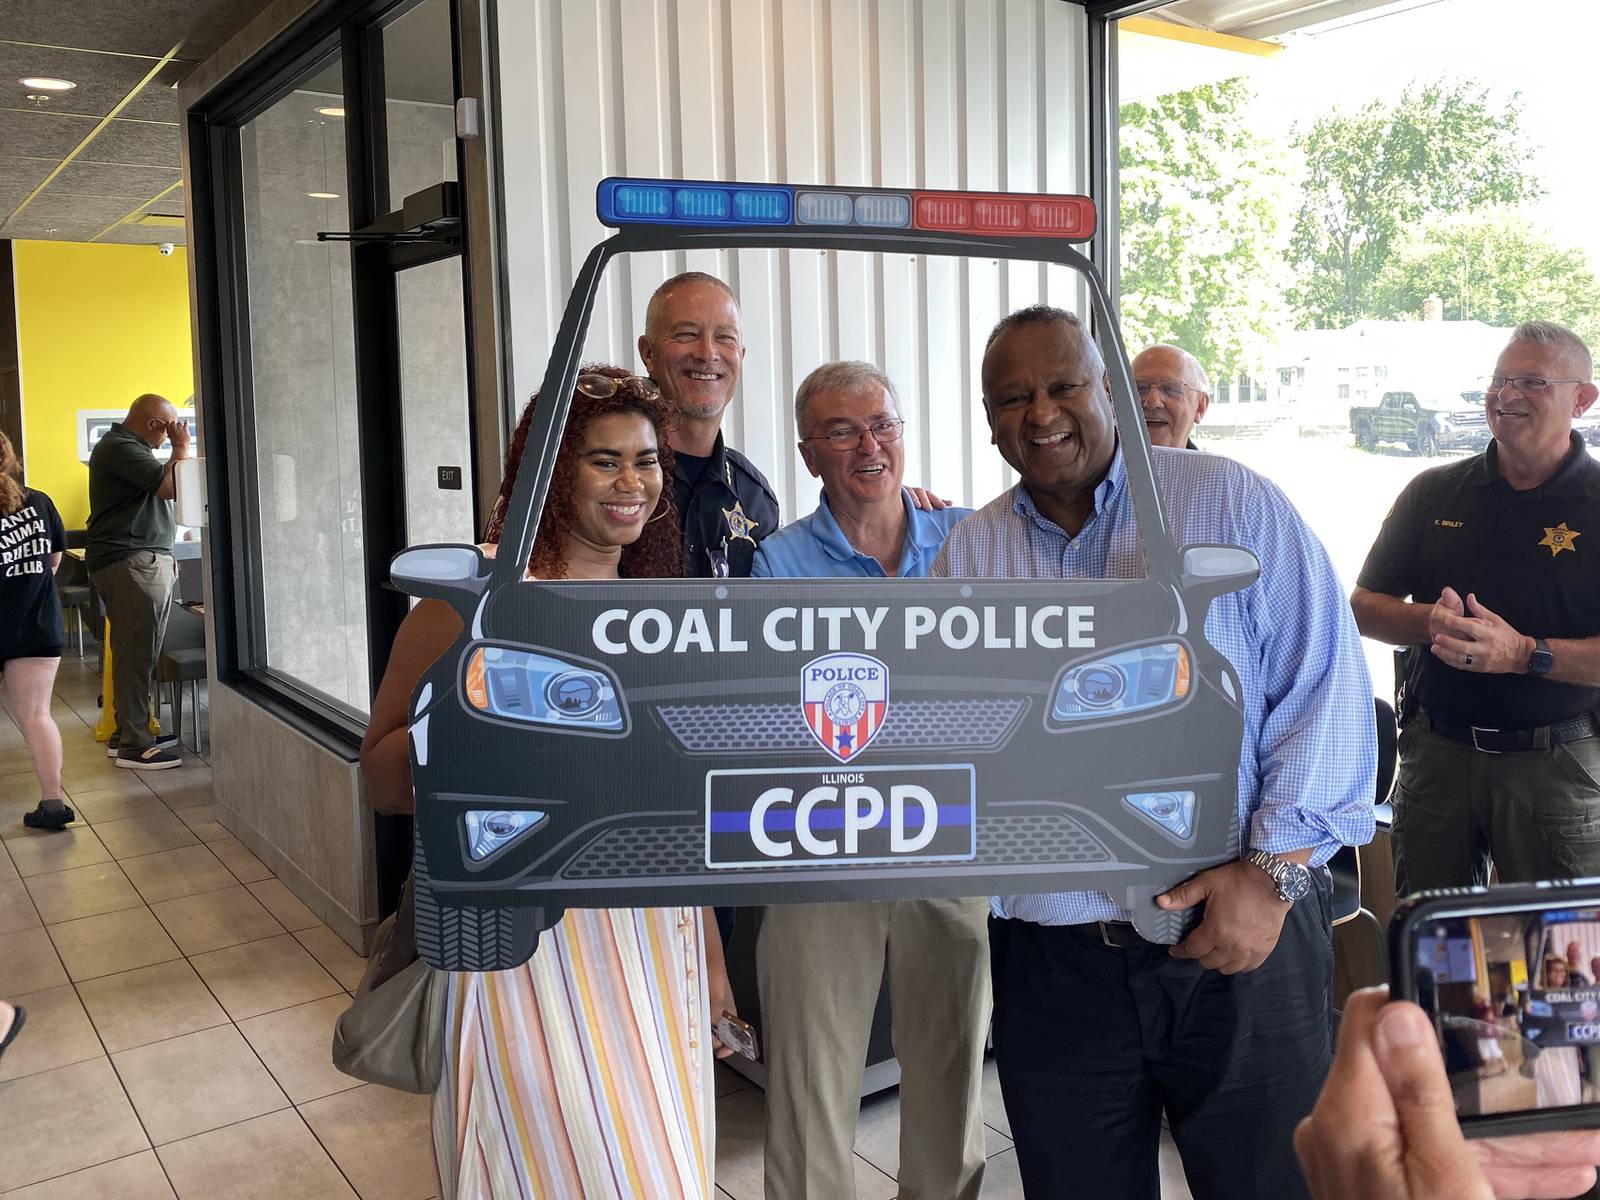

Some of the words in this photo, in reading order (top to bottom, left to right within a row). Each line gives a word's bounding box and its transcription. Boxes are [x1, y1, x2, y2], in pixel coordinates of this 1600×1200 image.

[442, 470, 454, 481] EXIT
[0, 506, 38, 531] ANTI
[0, 538, 52, 565] RUELTY
[6, 560, 44, 577] CLUB
[592, 608, 748, 654] COAL
[762, 606, 889, 651] CITY
[905, 605, 1096, 650] POLICE
[811, 667, 879, 681] POLICE
[822, 773, 865, 784] ILLINOIS
[749, 784, 939, 857] CCPD
